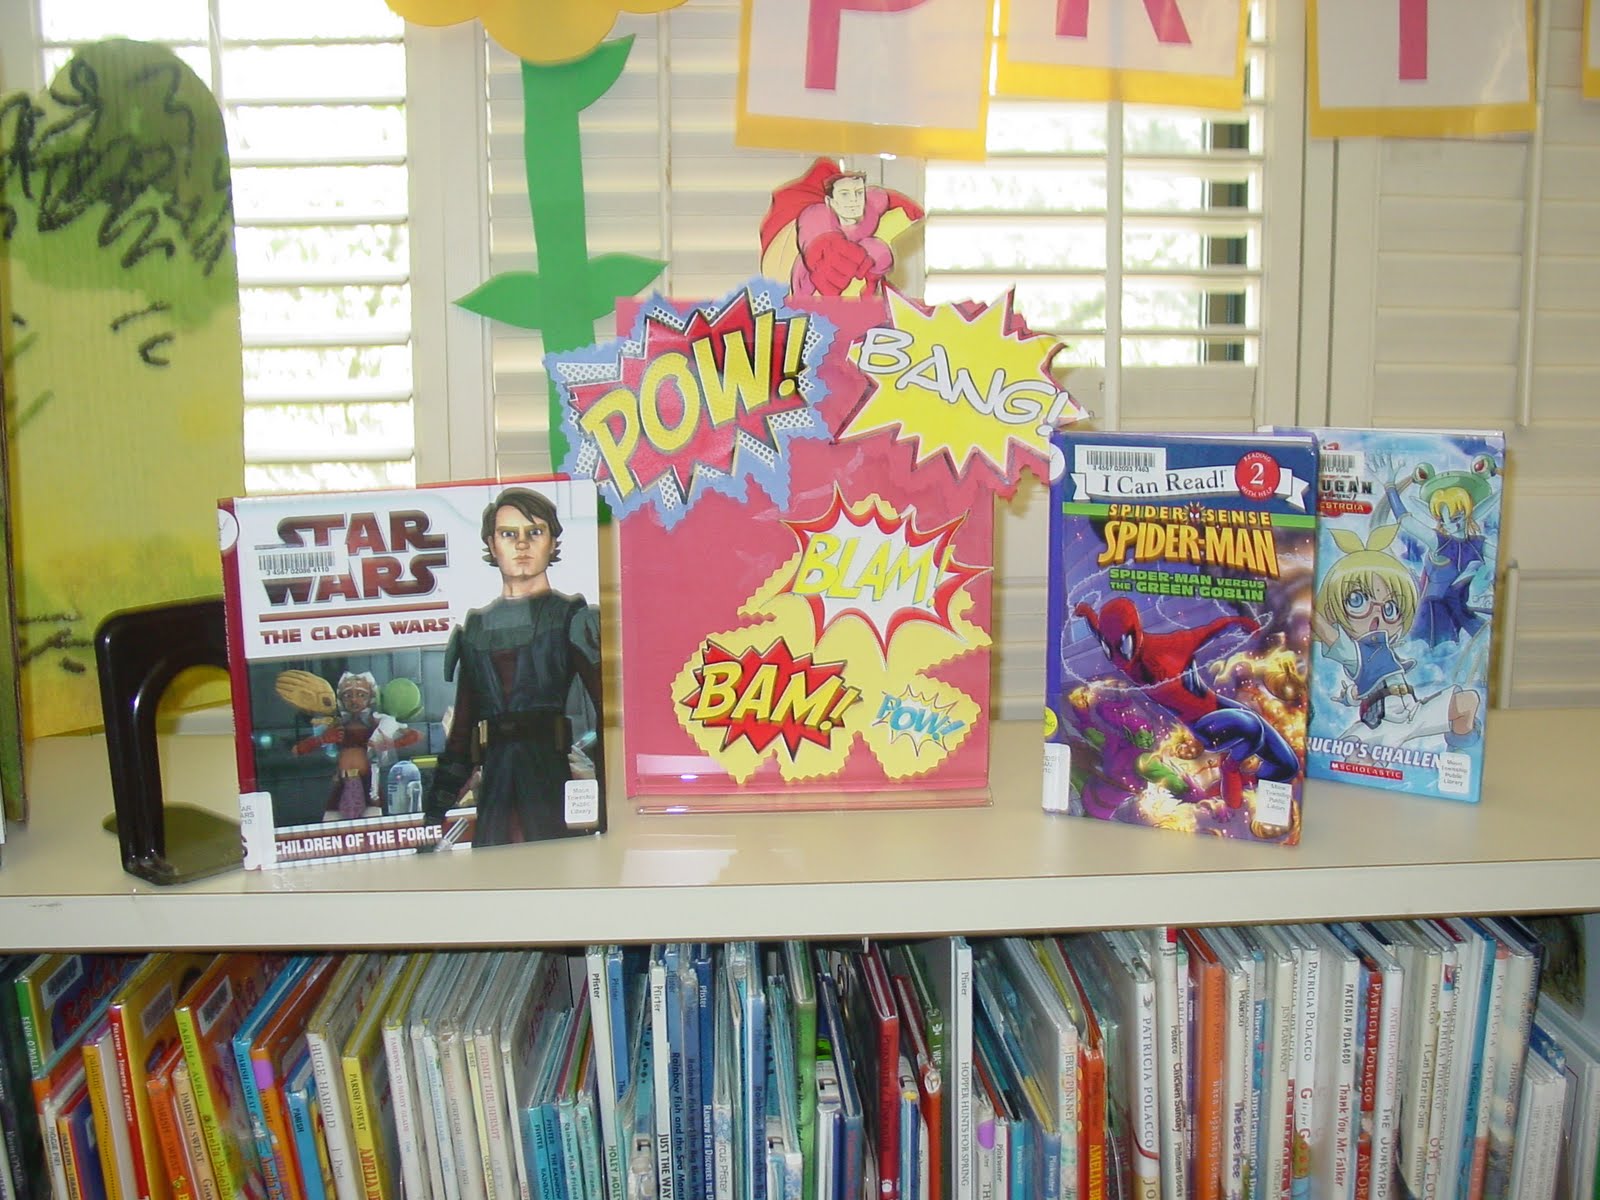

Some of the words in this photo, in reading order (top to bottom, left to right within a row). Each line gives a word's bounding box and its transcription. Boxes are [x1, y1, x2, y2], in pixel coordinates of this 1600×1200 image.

[858, 328, 1068, 438] BANG!
[580, 309, 809, 497] POW!
[1104, 474, 1111, 493] I
[1117, 475, 1158, 494] Can
[1166, 470, 1225, 492] Read!
[1250, 462, 1265, 486] 2
[1109, 503, 1184, 520] SPIDER
[1206, 509, 1271, 526] SENSE
[255, 509, 448, 555] STAR
[1098, 520, 1280, 578] SPIDER-MAN
[262, 552, 449, 606] WARS
[791, 532, 956, 608] BLAM!
[1109, 569, 1212, 586] SPIDER-MAN
[1216, 577, 1266, 590] VERSUS
[1110, 581, 1131, 591] THE
[1136, 582, 1193, 597] GREEN
[1199, 585, 1264, 602] GOBLIN
[260, 629, 301, 645] THE
[311, 623, 380, 640] CLONE
[389, 618, 450, 634] WARS
[689, 661, 862, 732] BAM!
[876, 694, 965, 742] POW!
[1340, 764, 1401, 778] SCHOLASTIC
[275, 837, 341, 855] CHILDREN
[345, 833, 364, 848] OF
[368, 829, 395, 845] THE
[399, 825, 442, 842] FORCE
[592, 973, 601, 999] Pfister
[699, 985, 707, 1008] Pfister
[960, 972, 969, 996] Pfister
[1306, 961, 1318, 1008] PATRICIA
[1280, 1006, 1290, 1020] JUST
[1343, 983, 1354, 1023] PATRICIA
[1368, 983, 1382, 1040] PATRICIA
[1429, 984, 1438, 1025] POLACCO
[1489, 975, 1504, 1047] PATRICIA
[22, 1017, 31, 1038] KEVIN
[1254, 1004, 1262, 1041] Polacco
[1281, 1022, 1290, 1047] PLAIN
[1303, 1011, 1316, 1061] POLACCO
[1388, 1007, 1398, 1050] PATRICIA
[1437, 1010, 1451, 1058] PATRICIA
[1142, 1017, 1152, 1081] PATRICIA
[1170, 1025, 1179, 1055] Polacco
[1341, 1027, 1353, 1064] POLACCO
[311, 1044, 326, 1076] HUGE
[479, 1045, 492, 1080] KERMIT
[671, 1052, 681, 1093] Rainbow
[1064, 1051, 1074, 1078] JERRY
[1279, 1049, 1289, 1073] FANCY
[1422, 1050, 1432, 1068] Can
[686, 1058, 696, 1095] Rainbow
[960, 1062, 969, 1098] HOPPER
[1173, 1063, 1183, 1098] Chicken
[1363, 1047, 1377, 1102] POLACCO
[1386, 1053, 1396, 1096] POLACCO
[1421, 1072, 1431, 1096] Hear
[1434, 1063, 1446, 1110] POLACCO
[318, 1082, 337, 1129] HAROLD
[484, 1084, 494, 1102] THE
[673, 1096, 682, 1114] Fish
[754, 1086, 763, 1125] Rainbow
[1064, 1080, 1074, 1122] PINKNEY
[1300, 1088, 1312, 1099] G
[1338, 1083, 1350, 1113] Thank
[1419, 1097, 1429, 1110] the
[1480, 1056, 1496, 1126] POLACCO
[293, 1108, 304, 1133] PARISH
[486, 1106, 500, 1140] HERMIT
[674, 1117, 683, 1134] and
[703, 1105, 712, 1133] RAINBOW
[961, 1101, 970, 1132] HUNTS
[1143, 1087, 1154, 1149] POLACCO
[1171, 1100, 1183, 1133] Sunday
[1233, 1101, 1244, 1125] The
[1336, 1116, 1349, 1135] You,
[1381, 1107, 1392, 1128] THE
[1418, 1111, 1428, 1128] Sun
[564, 1122, 574, 1152] Rainbow
[658, 1133, 669, 1154] JUST
[675, 1137, 684, 1152] the
[704, 1135, 713, 1148] FISH
[960, 1134, 970, 1152] FOR
[1233, 1126, 1243, 1151] Bee
[1336, 1138, 1347, 1155] Mr.
[359, 1148, 377, 1188] AMELIA
[609, 1145, 619, 1173] HOLEY
[660, 1157, 670, 1174] THE
[676, 1154, 685, 1171] Sea
[704, 1150, 714, 1181] DISCOVERS
[960, 1154, 970, 1186] SPRING
[1048, 1155, 1056, 1192] Pinkwater
[1089, 1145, 1102, 1186] AMELIA
[1232, 1153, 1242, 1179] Tree
[1335, 1158, 1347, 1186] Falker
[1359, 1153, 1369, 1172] AN
[1377, 1137, 1391, 1198] JUNKYARD
[661, 1177, 671, 1199] WAY
[719, 1165, 729, 1192] Pfister
